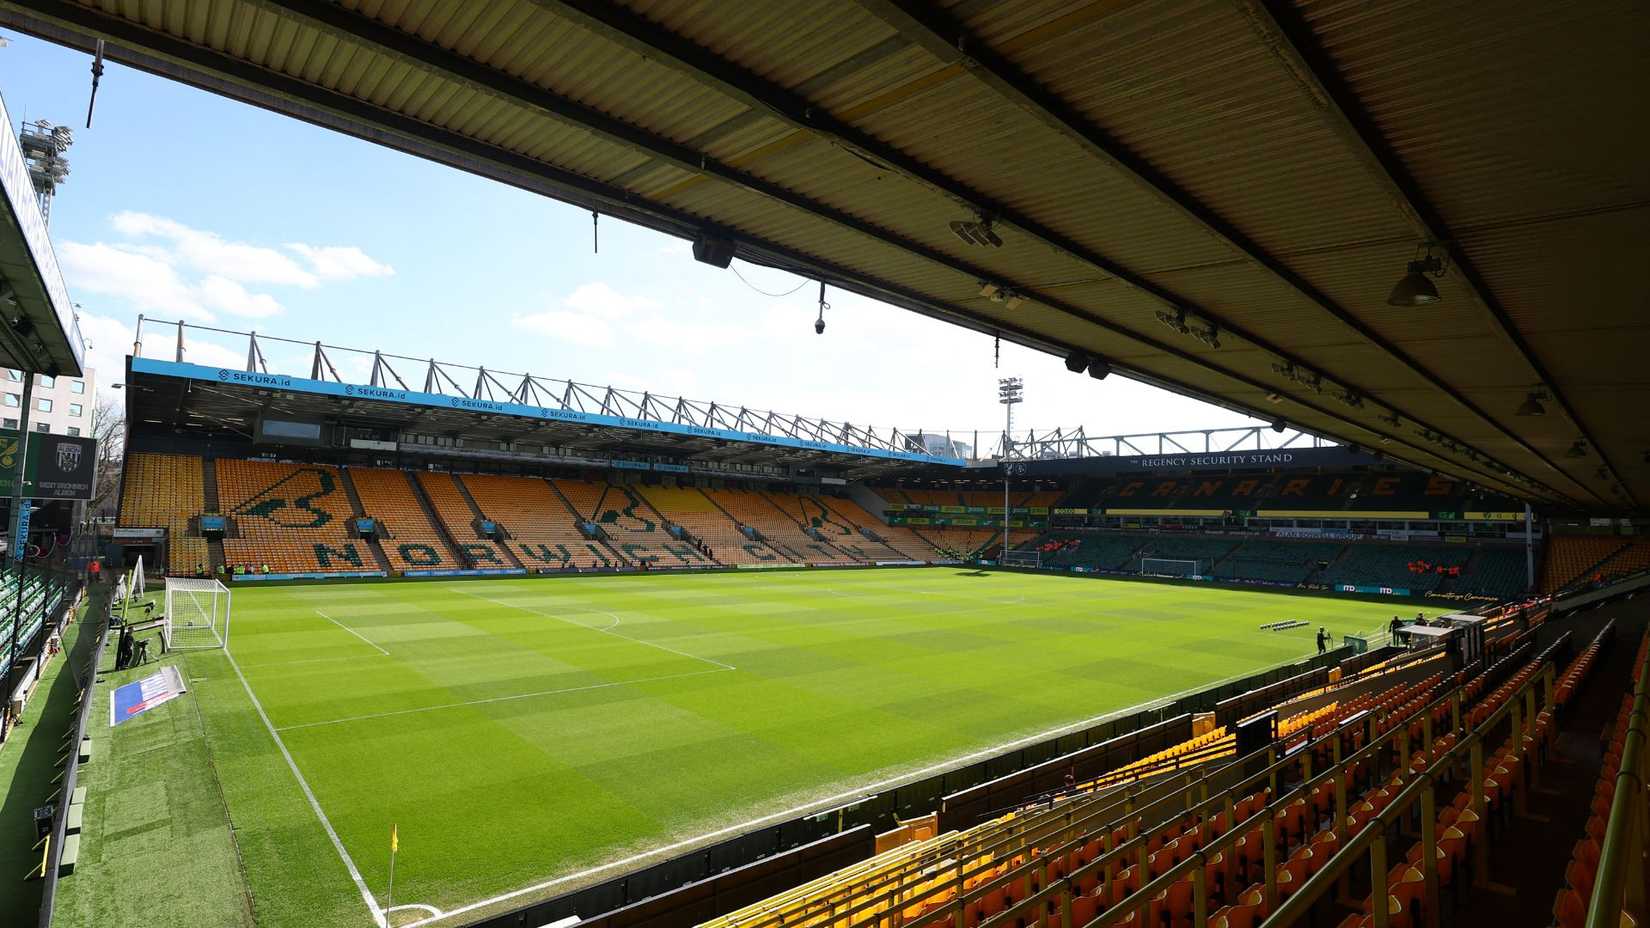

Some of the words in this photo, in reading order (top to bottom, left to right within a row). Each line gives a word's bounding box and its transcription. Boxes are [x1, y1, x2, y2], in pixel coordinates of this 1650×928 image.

[233, 372, 291, 387] SEKURA.id
[357, 388, 406, 400] SEKURA.id
[461, 400, 503, 411] SEKURA.id
[1141, 457, 1186, 467] REGENCY
[1190, 455, 1246, 465] SECURITY
[1251, 453, 1293, 463] STAND
[1119, 480, 1450, 496] CANARIES
[315, 543, 704, 568] NORWICH
